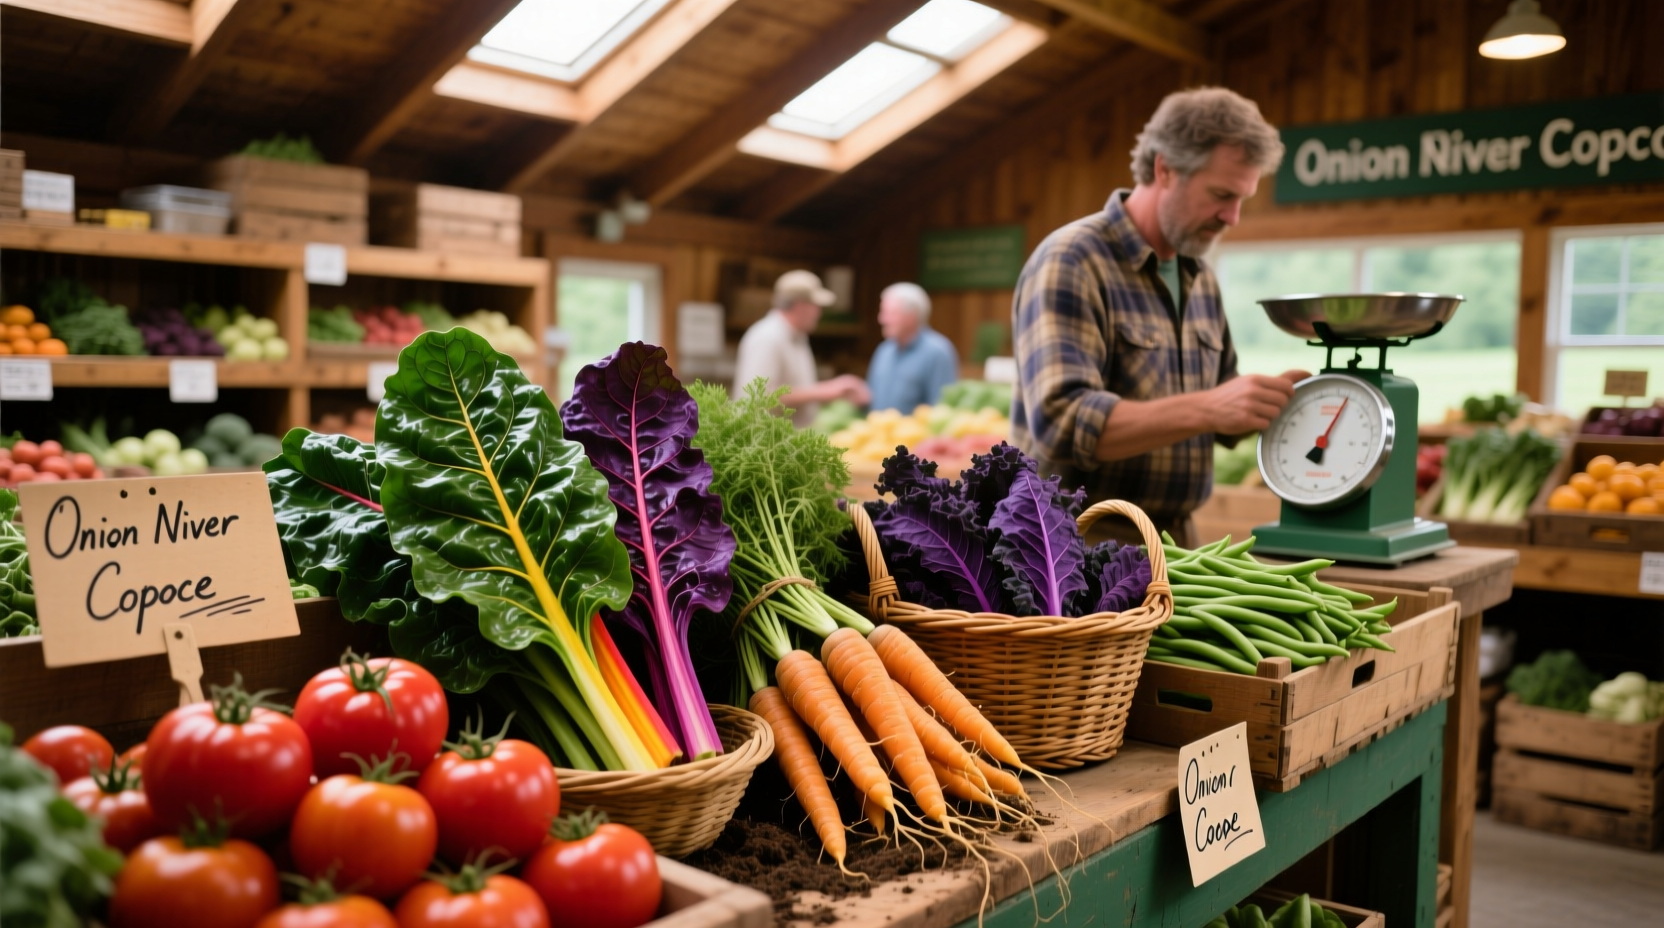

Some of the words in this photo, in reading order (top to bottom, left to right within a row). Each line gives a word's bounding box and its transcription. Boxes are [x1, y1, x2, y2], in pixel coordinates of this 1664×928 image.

[1295, 138, 1410, 186] Onion
[45, 496, 138, 559] Onion
[154, 500, 239, 544] Niver
[86, 561, 216, 634] Copoce
